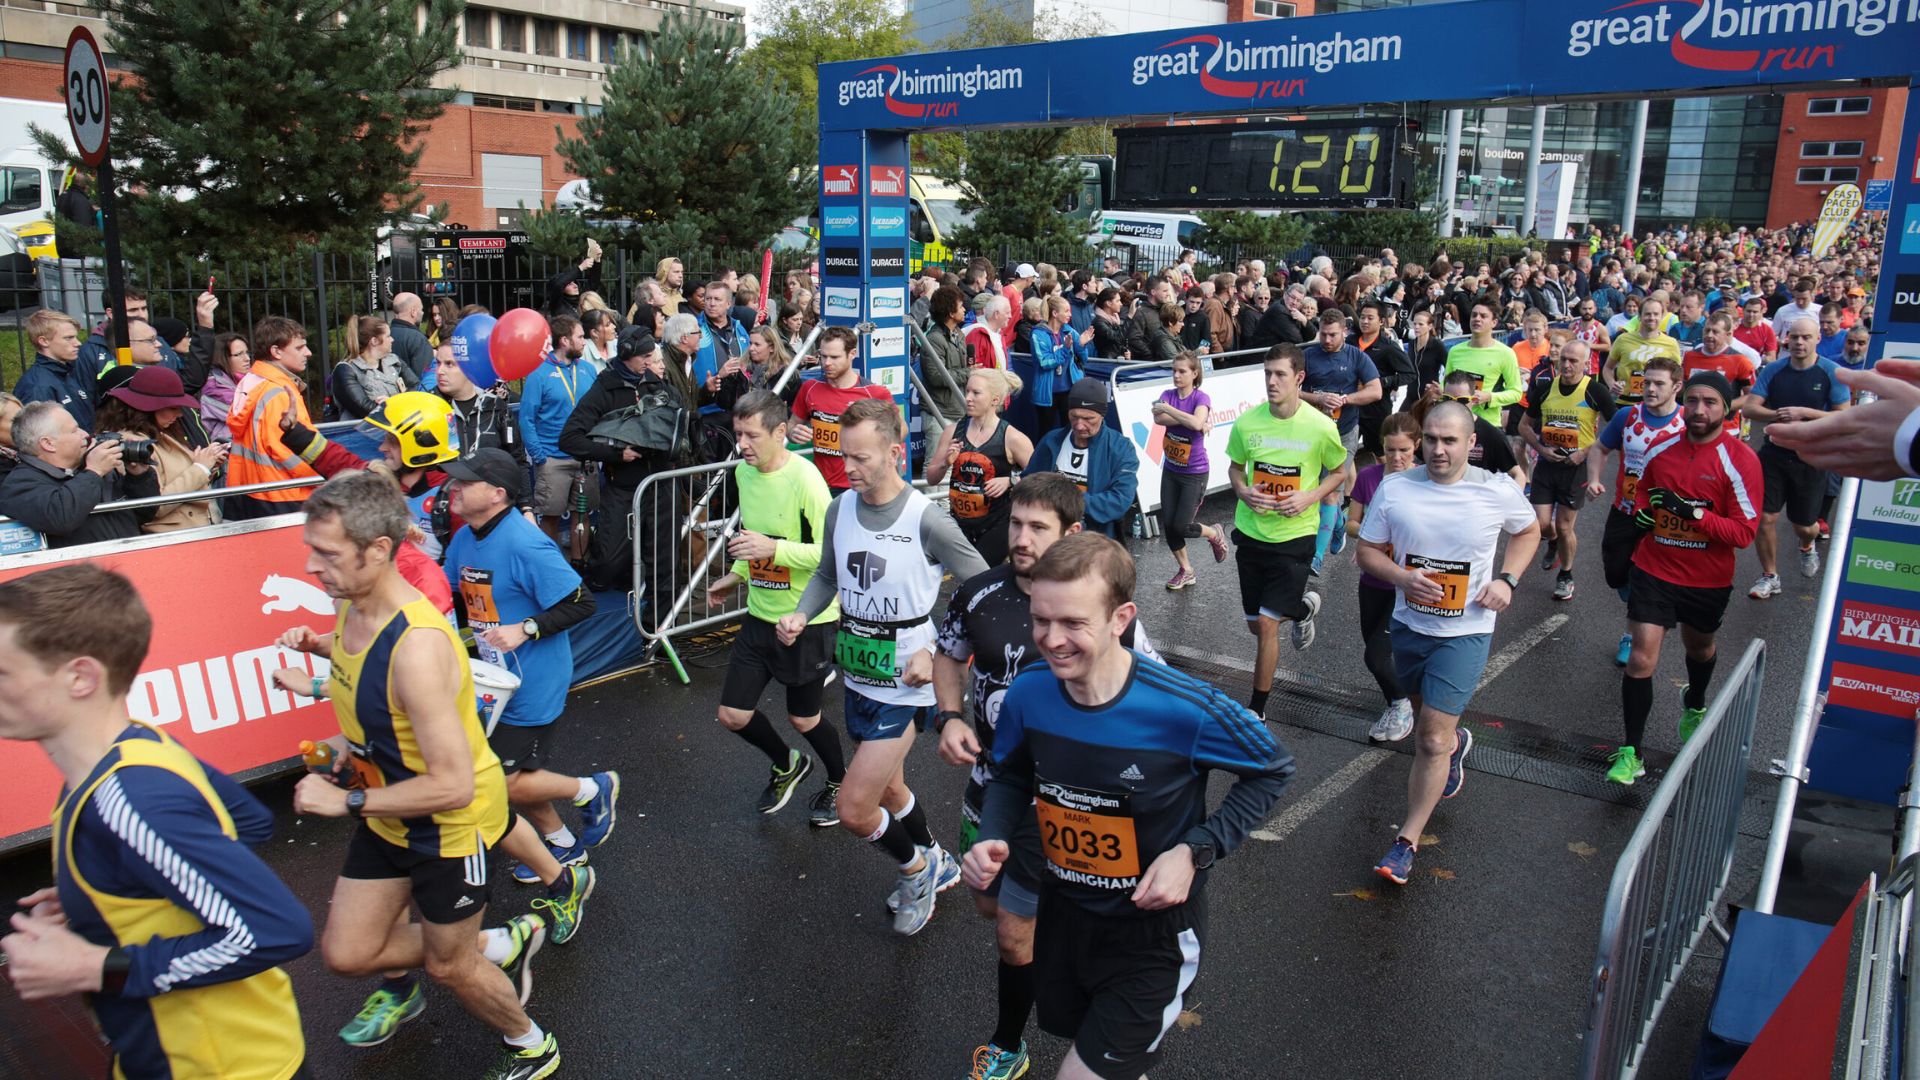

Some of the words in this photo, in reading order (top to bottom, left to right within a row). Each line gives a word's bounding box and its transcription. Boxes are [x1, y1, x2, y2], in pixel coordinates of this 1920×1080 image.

[1568, 5, 1671, 57] great
[1711, 0, 1920, 37] birmingh
[1132, 45, 1199, 86] great
[1225, 31, 1402, 74] birmingham
[1759, 44, 1835, 71] run
[838, 73, 884, 106] great
[902, 63, 1022, 98] birmingham
[1258, 78, 1305, 98] run
[70, 67, 103, 126] 30
[926, 101, 959, 118] run
[1484, 148, 1525, 160] boulton
[1539, 152, 1585, 162] campus
[824, 180, 850, 193] PUMA
[871, 180, 898, 194] PUMA
[1833, 190, 1858, 198] FAST
[1826, 199, 1859, 208] PACED
[1824, 207, 1849, 216] CLUB
[1105, 222, 1163, 236] enterprise
[462, 240, 504, 248] TEMPLANT
[825, 257, 859, 266] DURACELL
[871, 257, 904, 267] DURACELL
[1546, 432, 1574, 443] 3607
[960, 467, 984, 475] LAURA
[1872, 505, 1920, 522] Holiday
[1660, 514, 1698, 532] 390
[875, 533, 912, 543] orca
[1429, 560, 1464, 570] birmingham
[841, 587, 900, 616] TITAN
[838, 643, 891, 671] 11404
[1859, 682, 1920, 700] ATHLETICS
[1891, 695, 1920, 705] WEEKLY
[1064, 790, 1120, 808] birmingham
[1064, 811, 1091, 825] MARK
[1045, 820, 1122, 861] 2033
